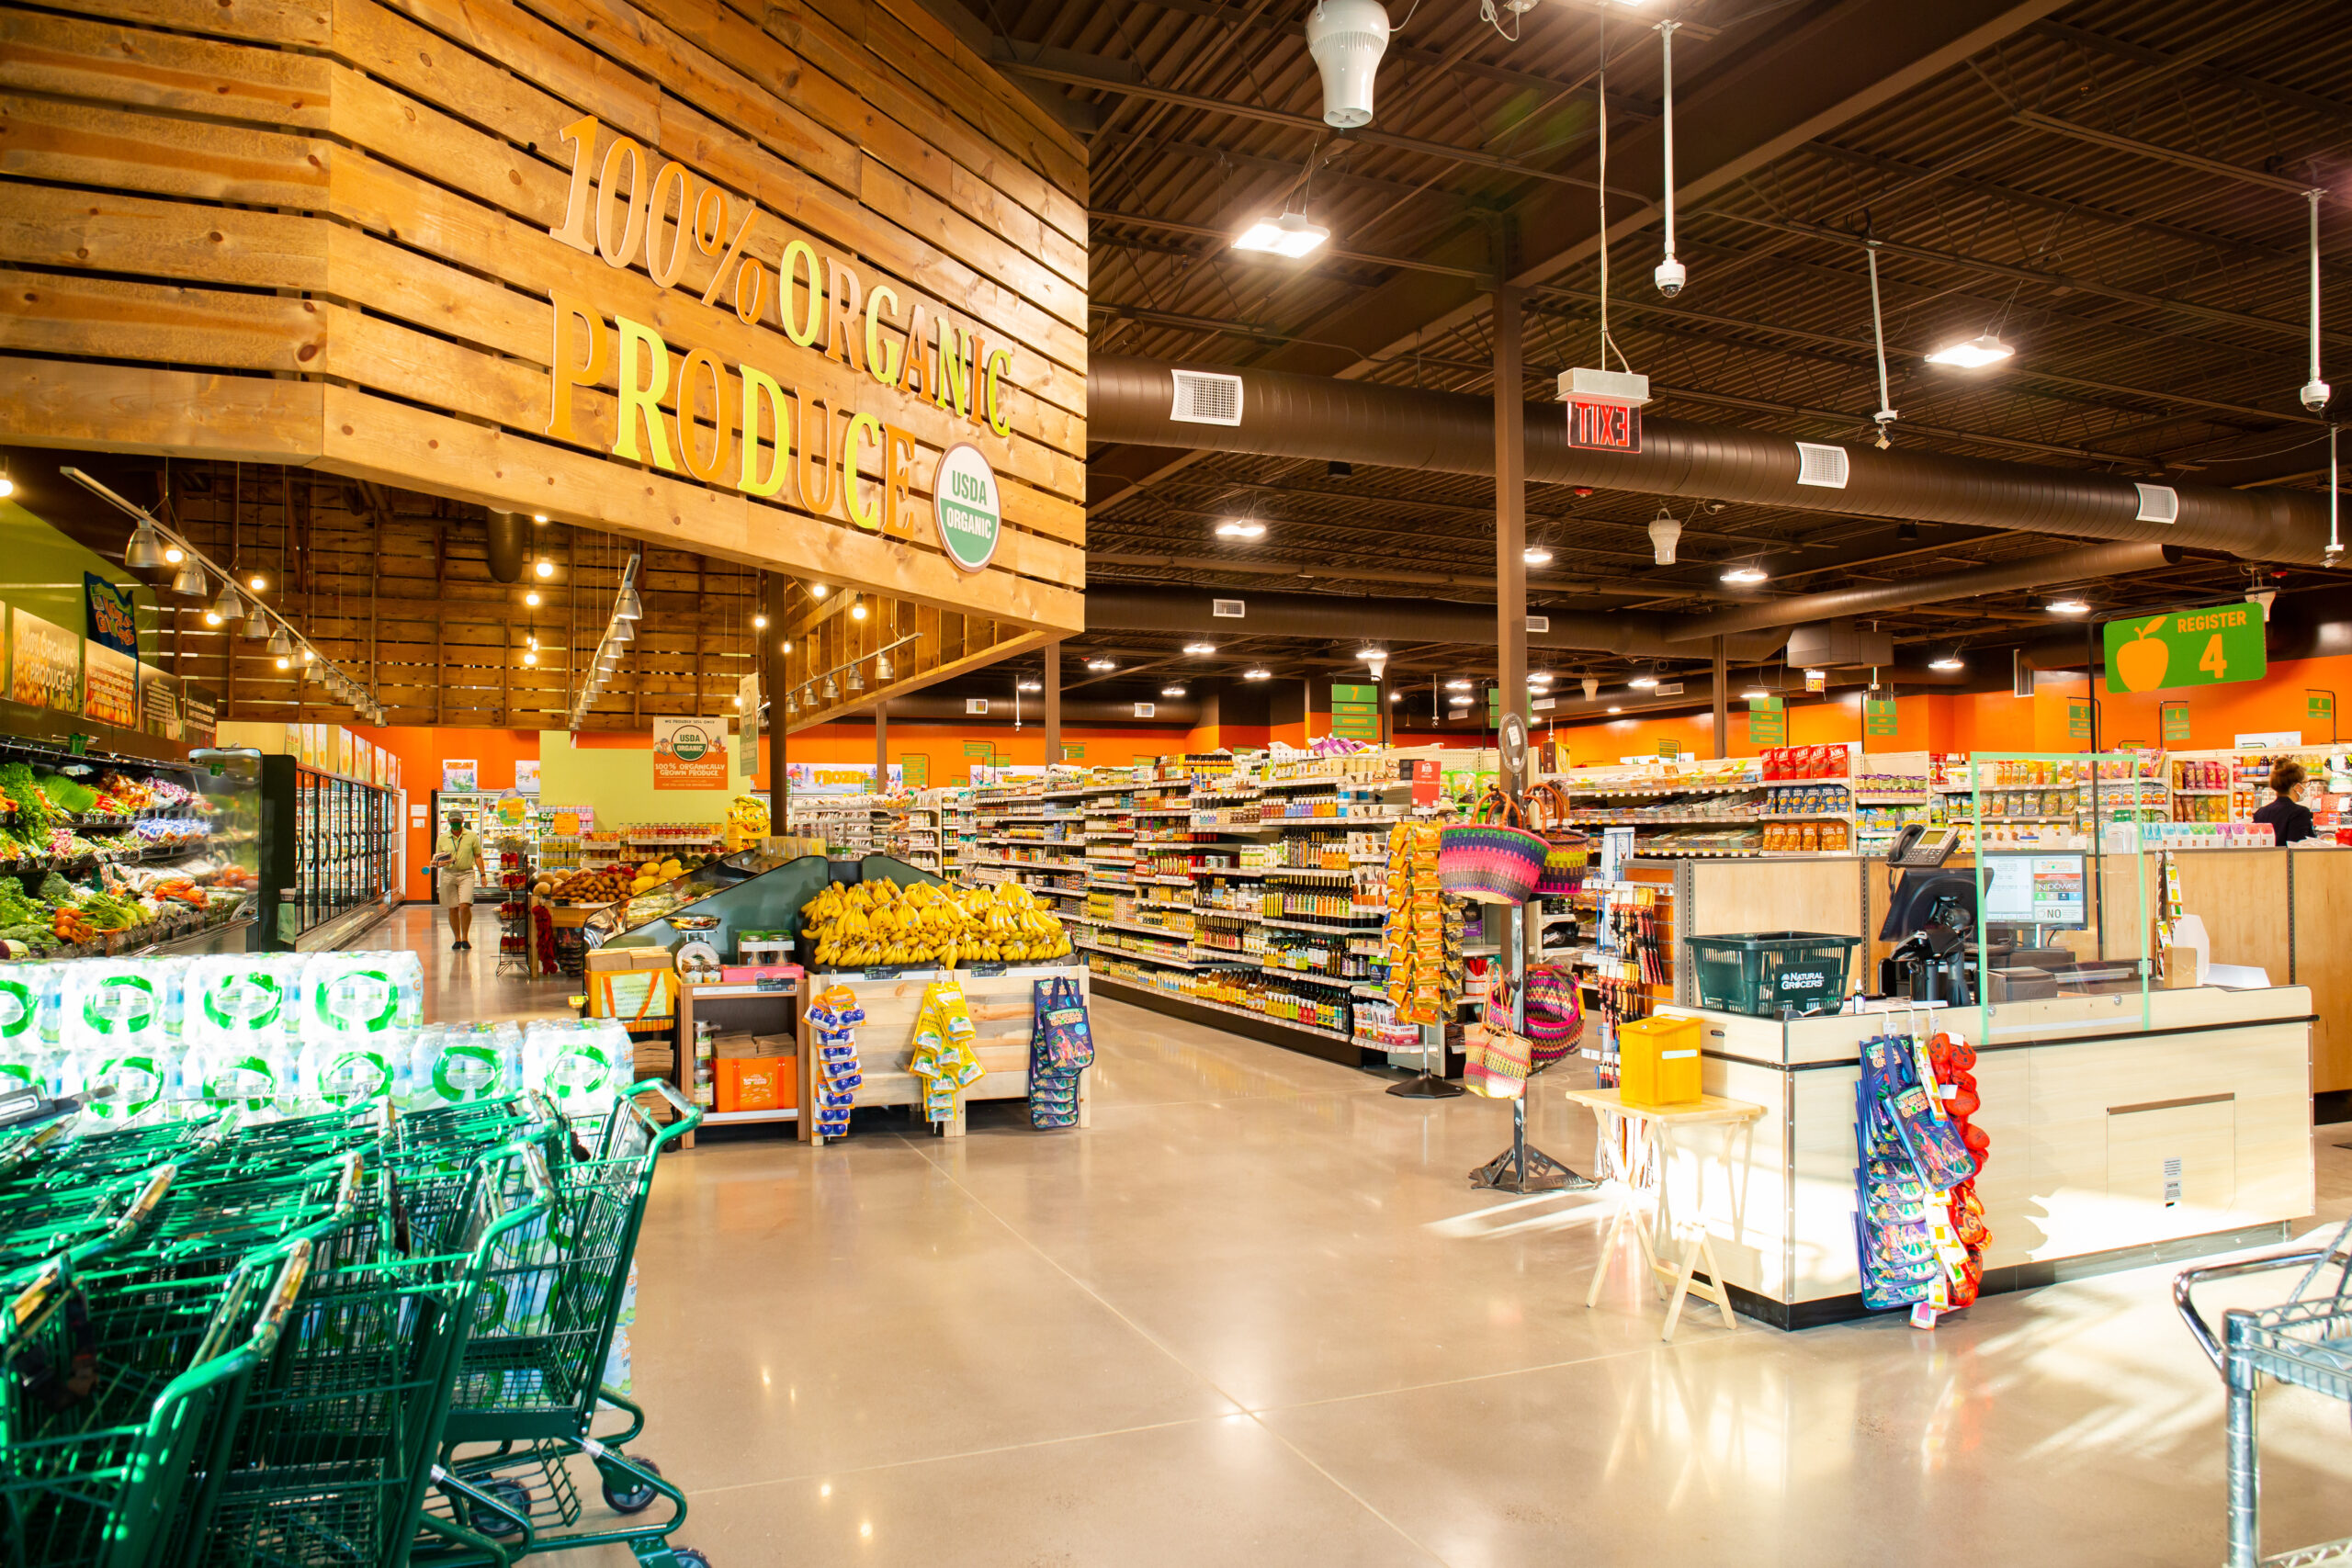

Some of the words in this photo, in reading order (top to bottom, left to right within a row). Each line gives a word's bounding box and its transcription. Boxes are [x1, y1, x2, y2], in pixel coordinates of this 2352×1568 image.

[549, 115, 766, 325] 100%
[779, 240, 1012, 437] ORGANIC
[545, 289, 915, 541] PRODUCE
[952, 469, 988, 507] USDA
[946, 506, 992, 540] ORGANIC
[2177, 610, 2246, 633] REGISTER
[20, 630, 40, 658] 100%
[41, 638, 74, 668] ORGANIC
[2199, 634, 2227, 679] 4
[29, 661, 66, 692] PRODUCE
[1351, 686, 1359, 701] 7
[1764, 697, 1770, 711] 6
[1879, 702, 1885, 714] 5
[2080, 707, 2086, 718] 5
[679, 734, 700, 742] USDA
[2047, 908, 2062, 919] NO
[1781, 979, 1823, 990] GROCERS
[1790, 972, 1825, 981] NATURAL
